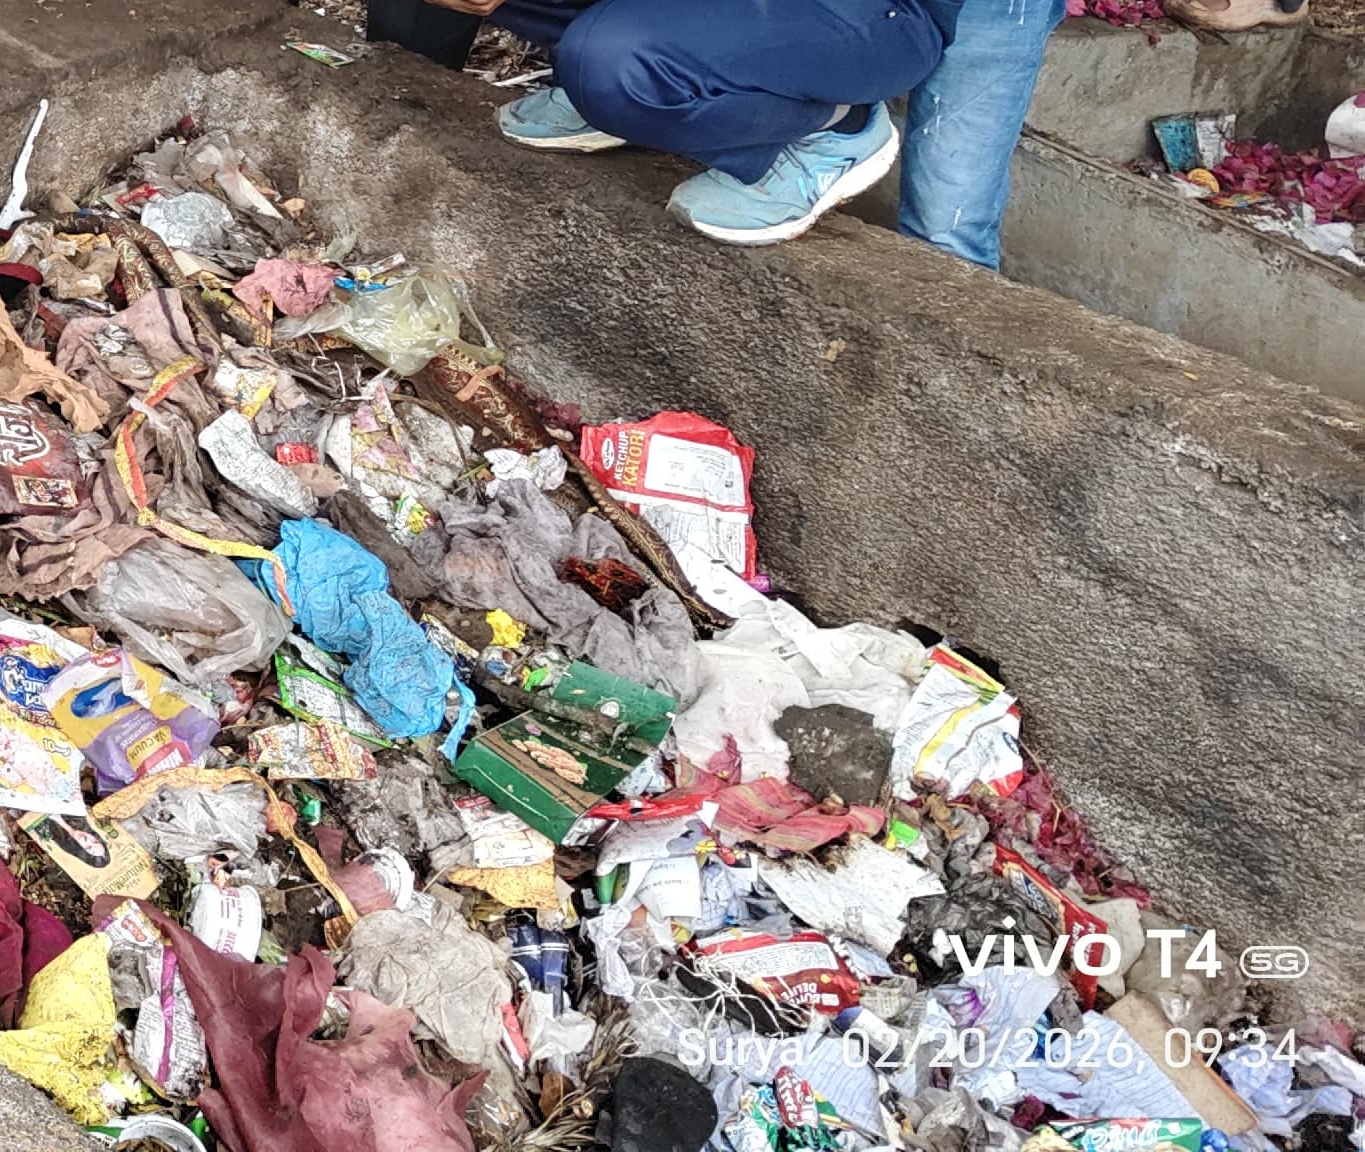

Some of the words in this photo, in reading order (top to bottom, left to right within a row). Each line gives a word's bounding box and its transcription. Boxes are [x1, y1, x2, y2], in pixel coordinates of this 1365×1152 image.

[613, 430, 630, 481] KETCHUP
[622, 428, 647, 488] KATORI
[127, 728, 171, 762] VACUUM
